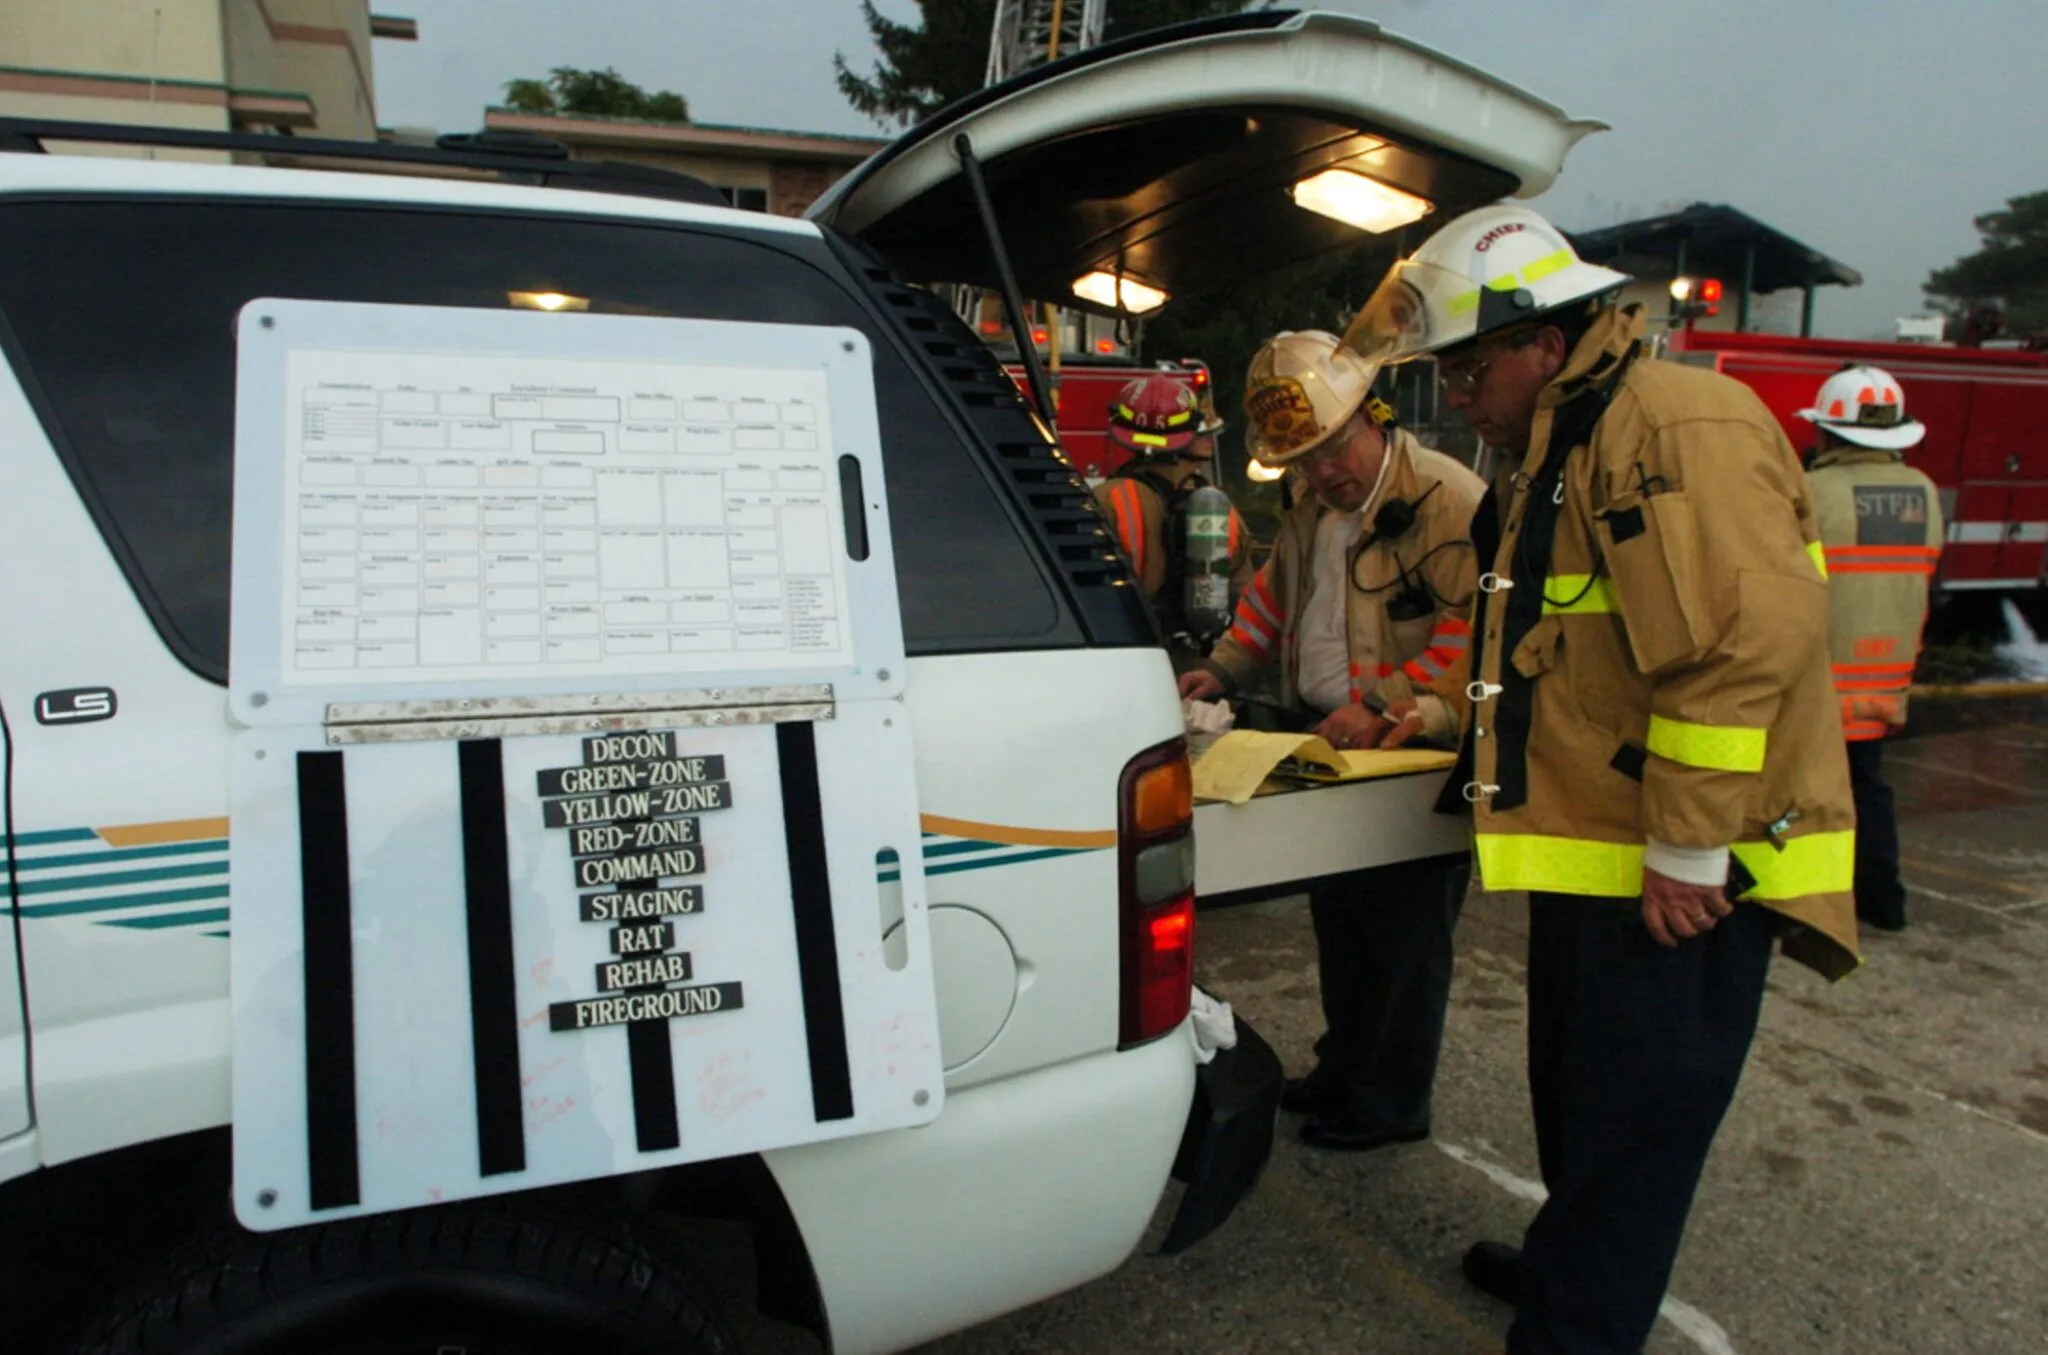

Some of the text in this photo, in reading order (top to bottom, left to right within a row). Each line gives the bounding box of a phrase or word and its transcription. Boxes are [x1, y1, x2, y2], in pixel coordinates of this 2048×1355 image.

[1474, 223, 1525, 253] CHIEF
[1856, 492, 1926, 518] STFD
[41, 692, 111, 719] LS
[591, 733, 668, 762] DECON
[560, 759, 706, 793] GREEN-ZONE
[560, 785, 721, 825] YELLOW-ZONE
[577, 819, 693, 854] RED-ZONE
[582, 850, 696, 886] COMMAND
[591, 889, 694, 921] STAGING
[618, 925, 665, 953] RAT
[606, 957, 685, 989] REHAB
[575, 987, 722, 1028] FIREGROUND
